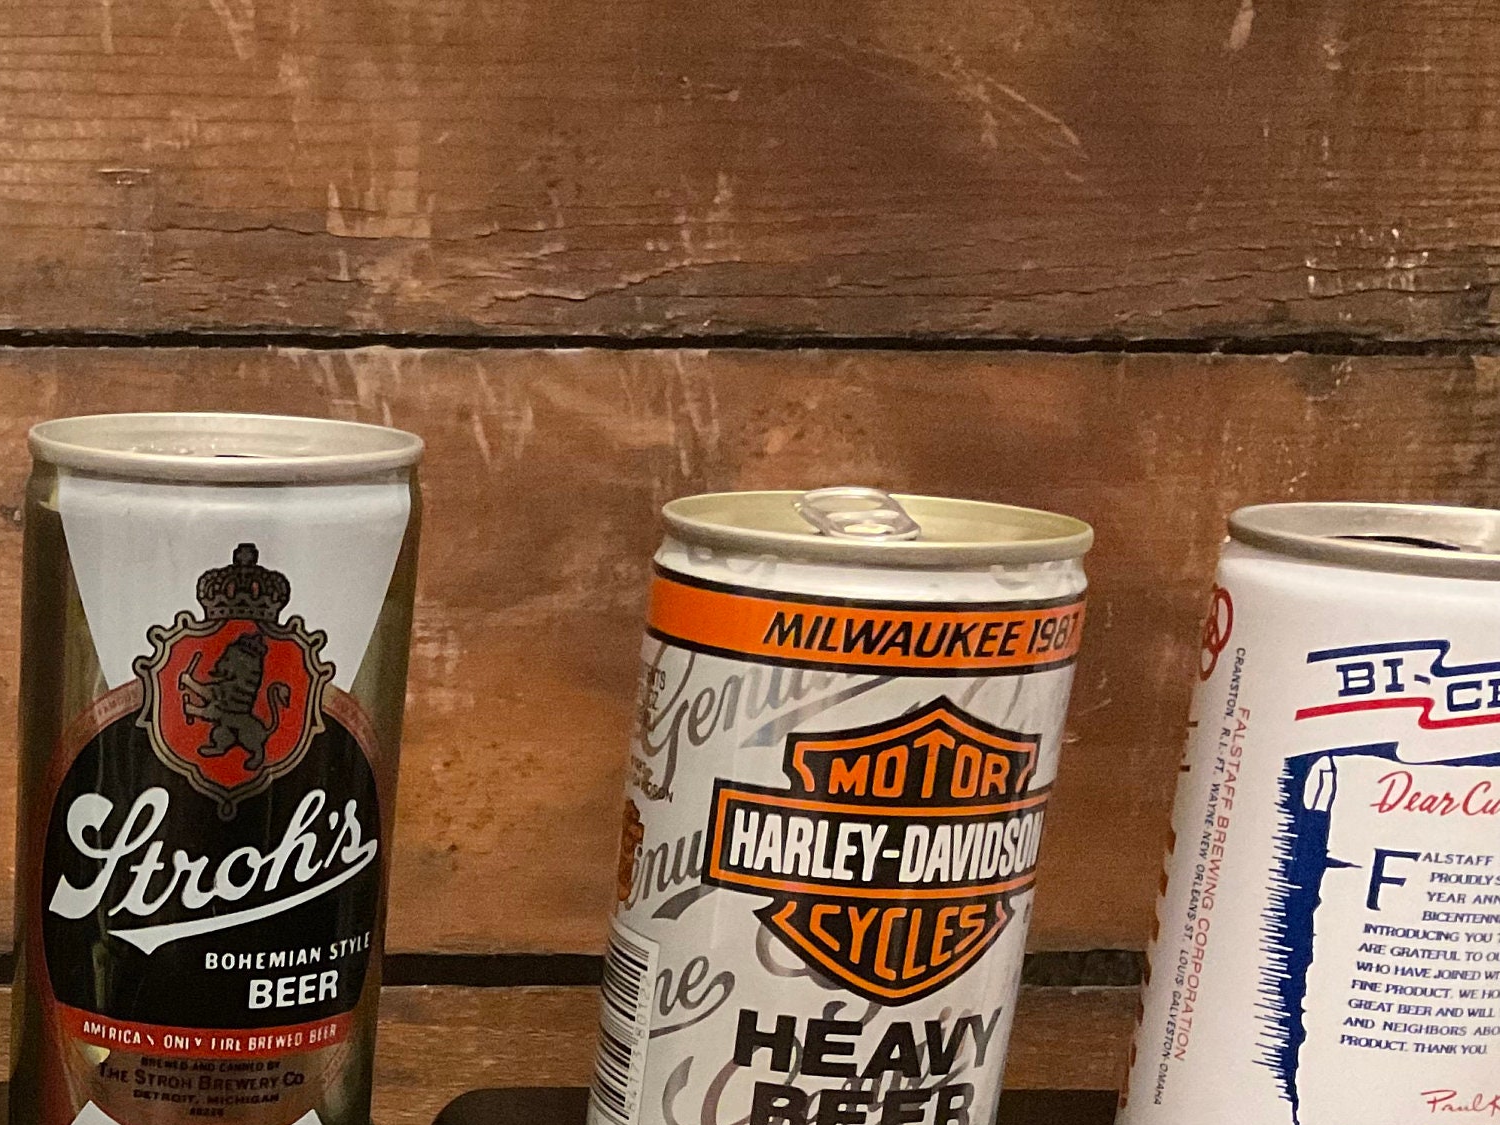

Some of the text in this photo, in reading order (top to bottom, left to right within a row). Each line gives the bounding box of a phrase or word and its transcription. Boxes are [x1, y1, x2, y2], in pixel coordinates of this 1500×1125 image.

[762, 611, 1027, 658] MILWAUKEE
[828, 729, 1011, 798] MOTOR
[1370, 770, 1461, 816] Dear
[48, 786, 378, 920] Stroh's
[728, 807, 1045, 884] HARLEY-DAVIDSON
[1174, 706, 1250, 1061] FALSTAFF BREWING CORPORATION
[1429, 871, 1494, 886] PROUDLY
[1426, 891, 1466, 904] YEAR
[808, 904, 987, 981] CYCLES
[1363, 923, 1494, 943] INTRODUCING YOU
[205, 931, 371, 970] BOHEMIAN STYLE
[1357, 942, 1483, 962] ARE GRATEFUL TO
[1356, 960, 1391, 975] WHO
[1394, 965, 1432, 979] HAVE
[1433, 969, 1481, 981] JOINED
[248, 969, 339, 1010] BEER
[1351, 978, 1383, 993] FINE
[1458, 988, 1478, 999] WE
[1348, 998, 1496, 1018] GREAT BEER AND WILL
[309, 1023, 338, 1044] BEER
[1343, 1016, 1375, 1029] AND
[1382, 1020, 1467, 1037] NEIGHBORS
[733, 1006, 1003, 1080] HEAVY
[1413, 1042, 1457, 1055] THANK
